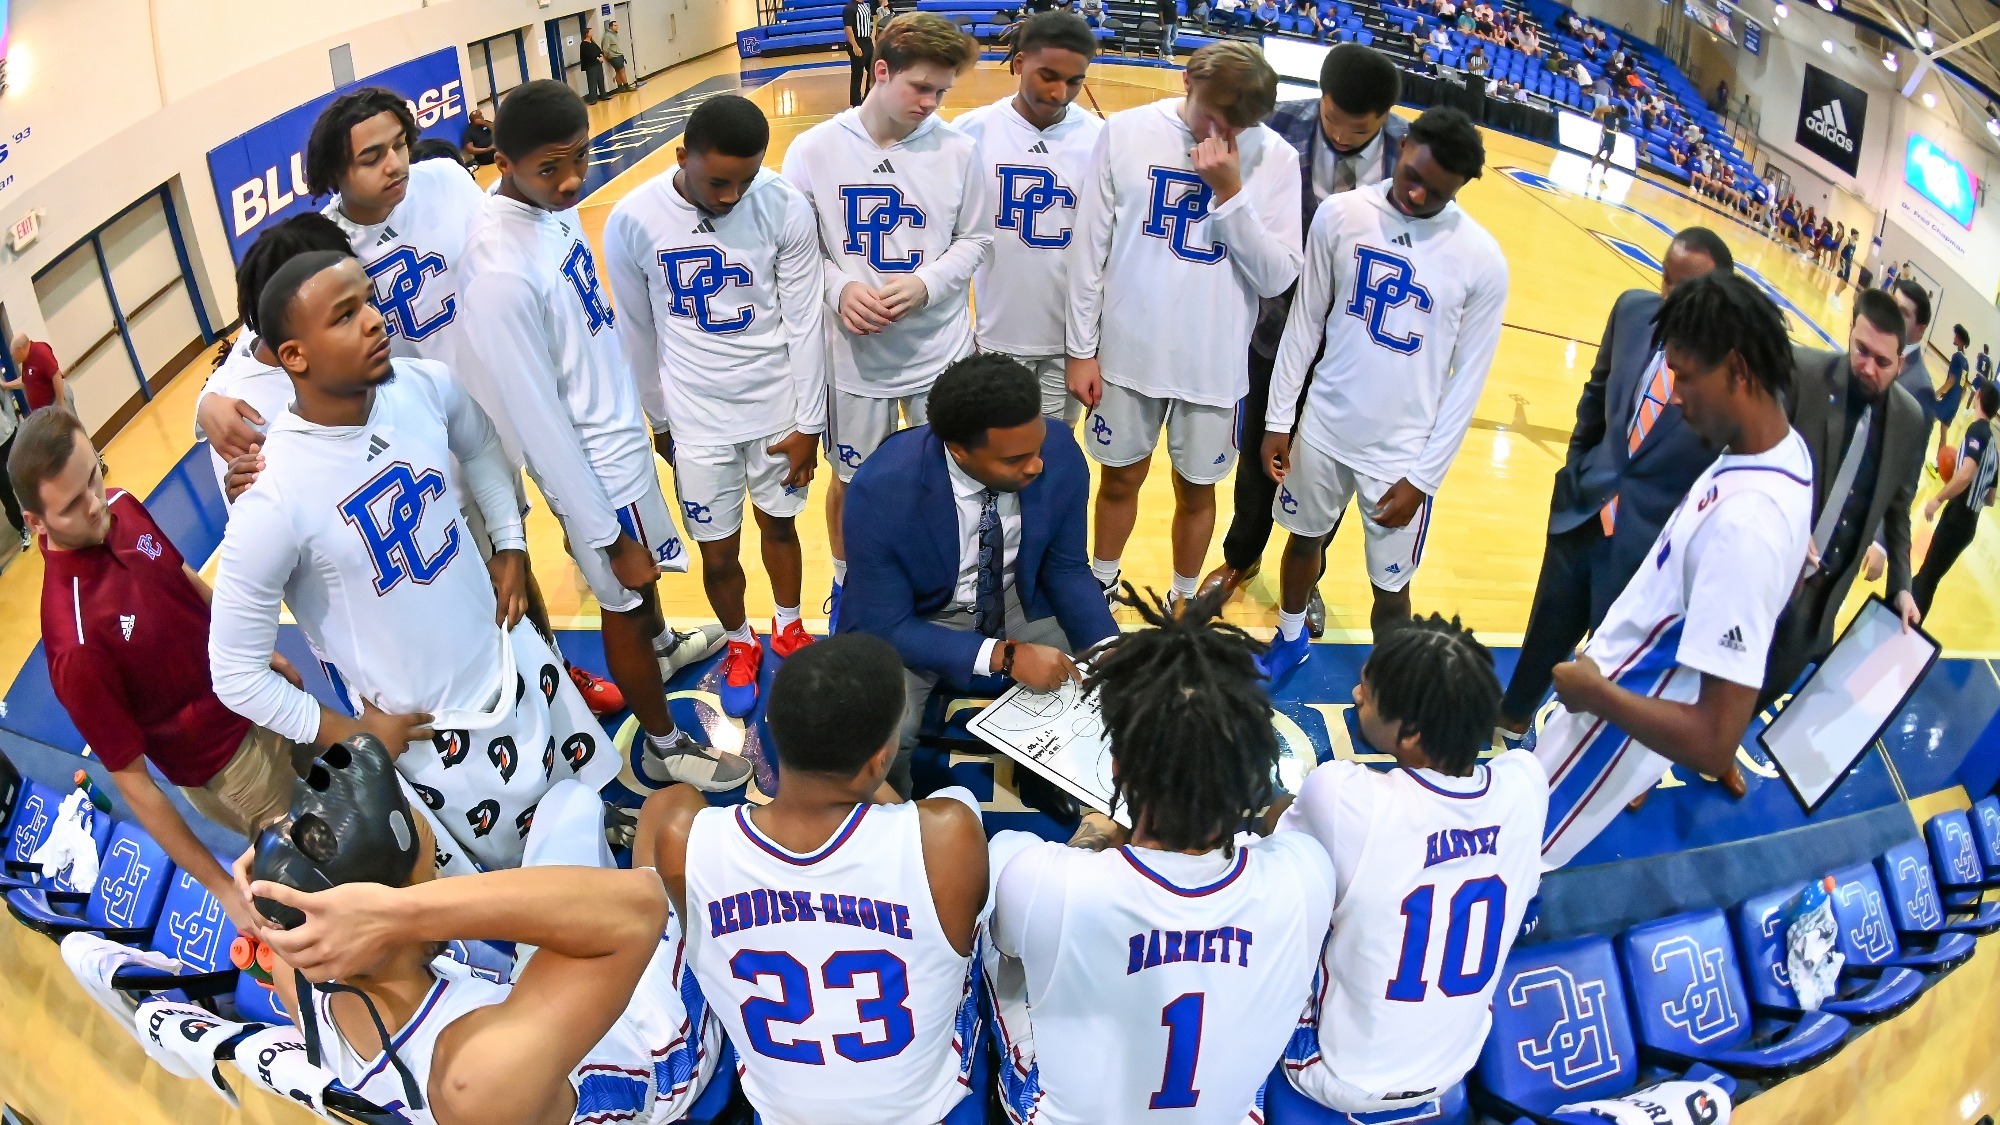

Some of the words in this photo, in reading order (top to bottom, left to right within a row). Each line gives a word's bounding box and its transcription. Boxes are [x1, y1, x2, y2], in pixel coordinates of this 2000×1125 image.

[12, 126, 31, 144] '93
[1805, 116, 1854, 153] adidas
[16, 215, 33, 240] EXIT
[839, 183, 927, 274] PC
[995, 163, 1078, 250] PC
[1142, 164, 1228, 266] PC
[1931, 223, 1965, 255] Chapman
[656, 244, 756, 335] PC
[1344, 243, 1434, 357] PC
[136, 533, 163, 561] PC
[336, 460, 461, 598] PC
[1423, 825, 1501, 870] HARVEY
[707, 888, 914, 941] REDDISH-RHONE
[1126, 926, 1253, 976] BARNETT
[1385, 873, 1508, 1003] 10
[728, 948, 916, 1067] 23
[1148, 991, 1205, 1110] 1
